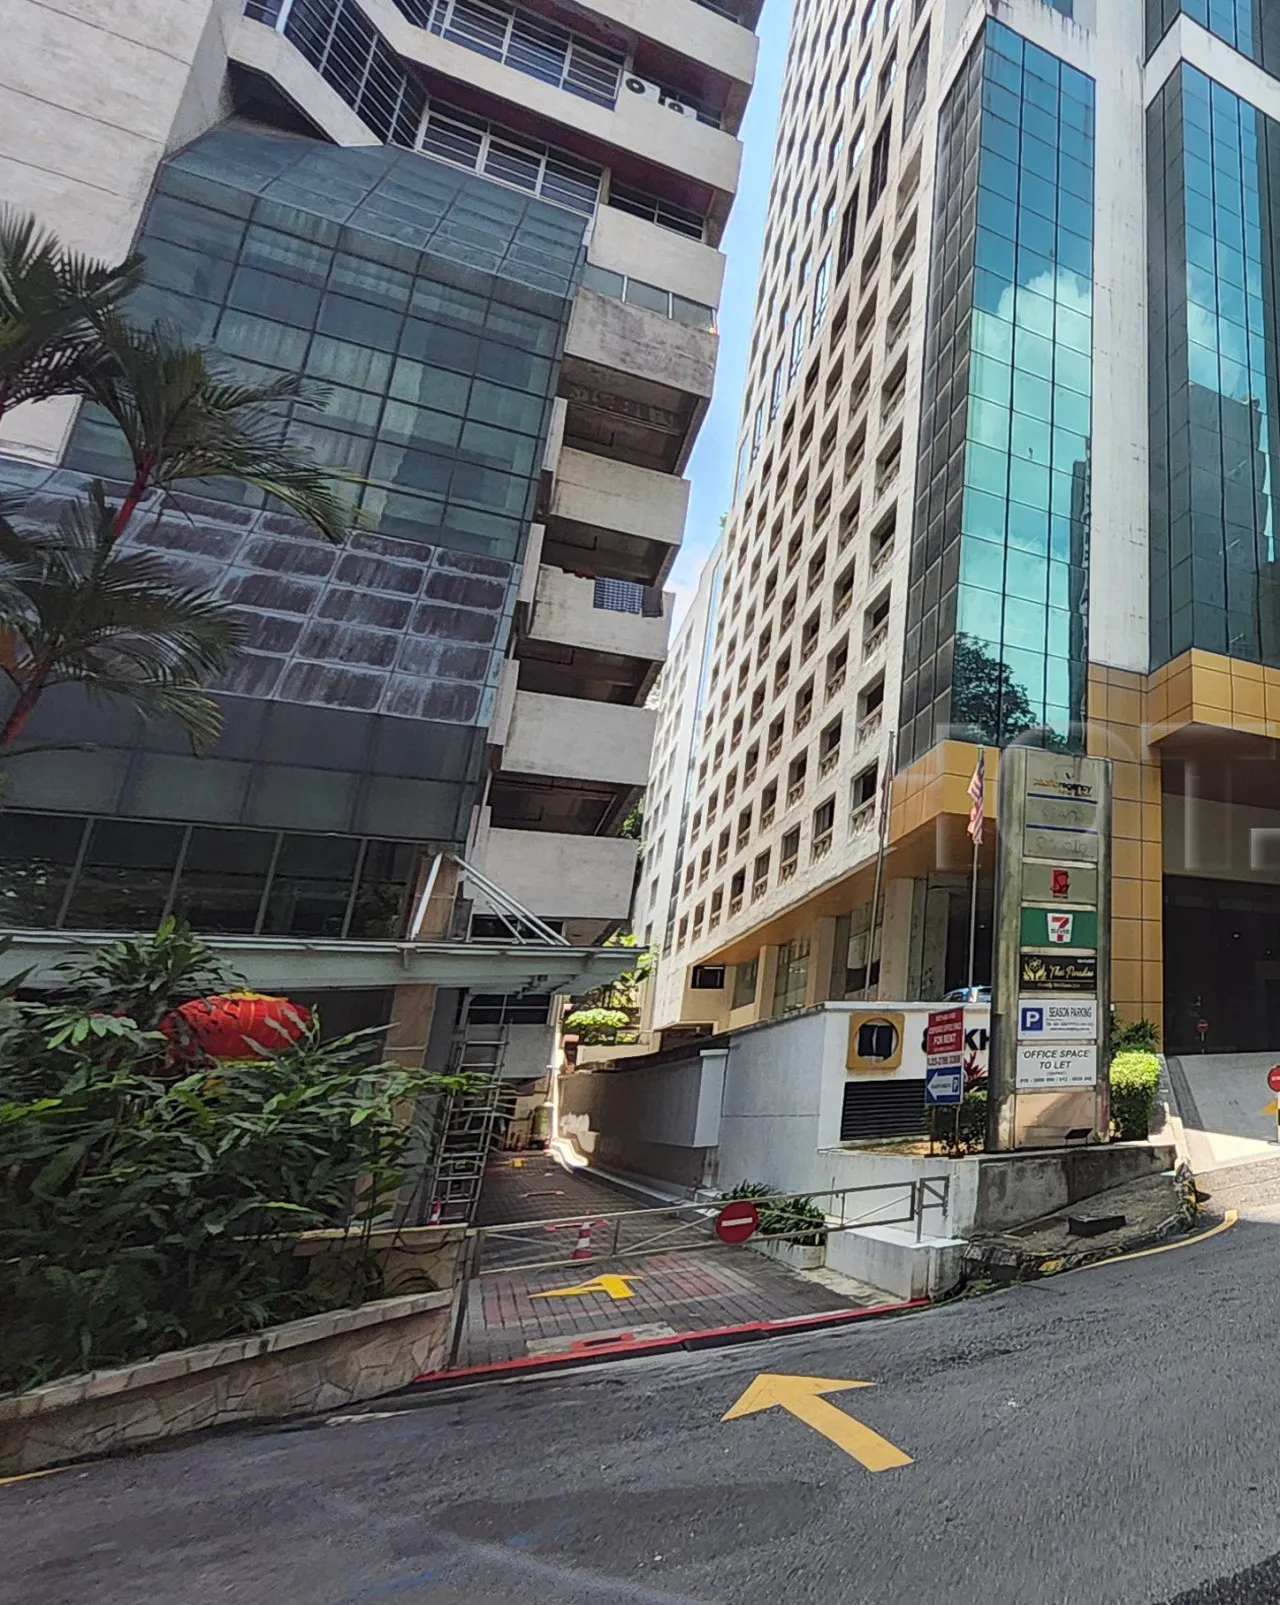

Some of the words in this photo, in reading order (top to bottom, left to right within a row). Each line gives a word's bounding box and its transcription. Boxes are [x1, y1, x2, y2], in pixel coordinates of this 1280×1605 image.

[1049, 1006, 1069, 1017] SEASON
[1071, 1006, 1093, 1018] PARKING
[1026, 1011, 1040, 1027] P
[1023, 1050, 1058, 1059] OFFICE
[1060, 1050, 1090, 1058] SPACE
[1040, 1061, 1051, 1069] TO
[1054, 1061, 1072, 1069] LET
